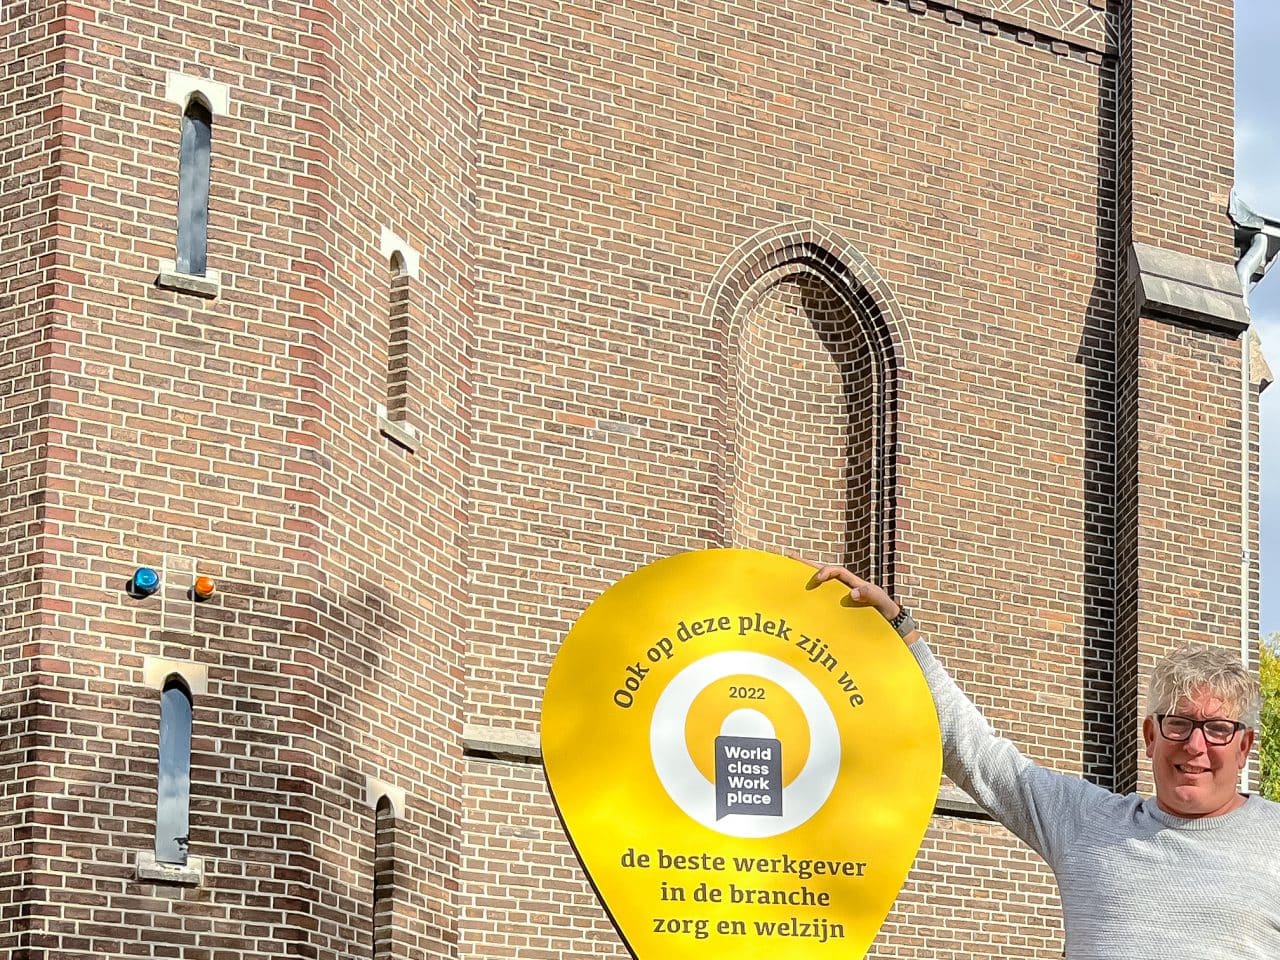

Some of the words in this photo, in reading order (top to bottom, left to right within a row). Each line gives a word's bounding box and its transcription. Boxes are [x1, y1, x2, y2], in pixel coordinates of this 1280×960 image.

[613, 663, 649, 709] Ook
[647, 636, 674, 663] op
[677, 615, 731, 641] deze
[739, 613, 792, 641] plek
[796, 632, 837, 672] zijn
[838, 673, 864, 707] we
[729, 686, 765, 700] 2022
[724, 746, 771, 760] World
[727, 761, 769, 775] class
[728, 776, 770, 790] Work
[727, 791, 771, 807] place
[621, 848, 650, 868] de
[658, 850, 725, 871] beste
[733, 854, 867, 879] werkgever
[661, 881, 686, 902] in
[693, 883, 722, 903] de
[730, 884, 830, 906] branche
[653, 917, 709, 939] zorg
[717, 919, 746, 936] en
[754, 917, 845, 943] welzijn
